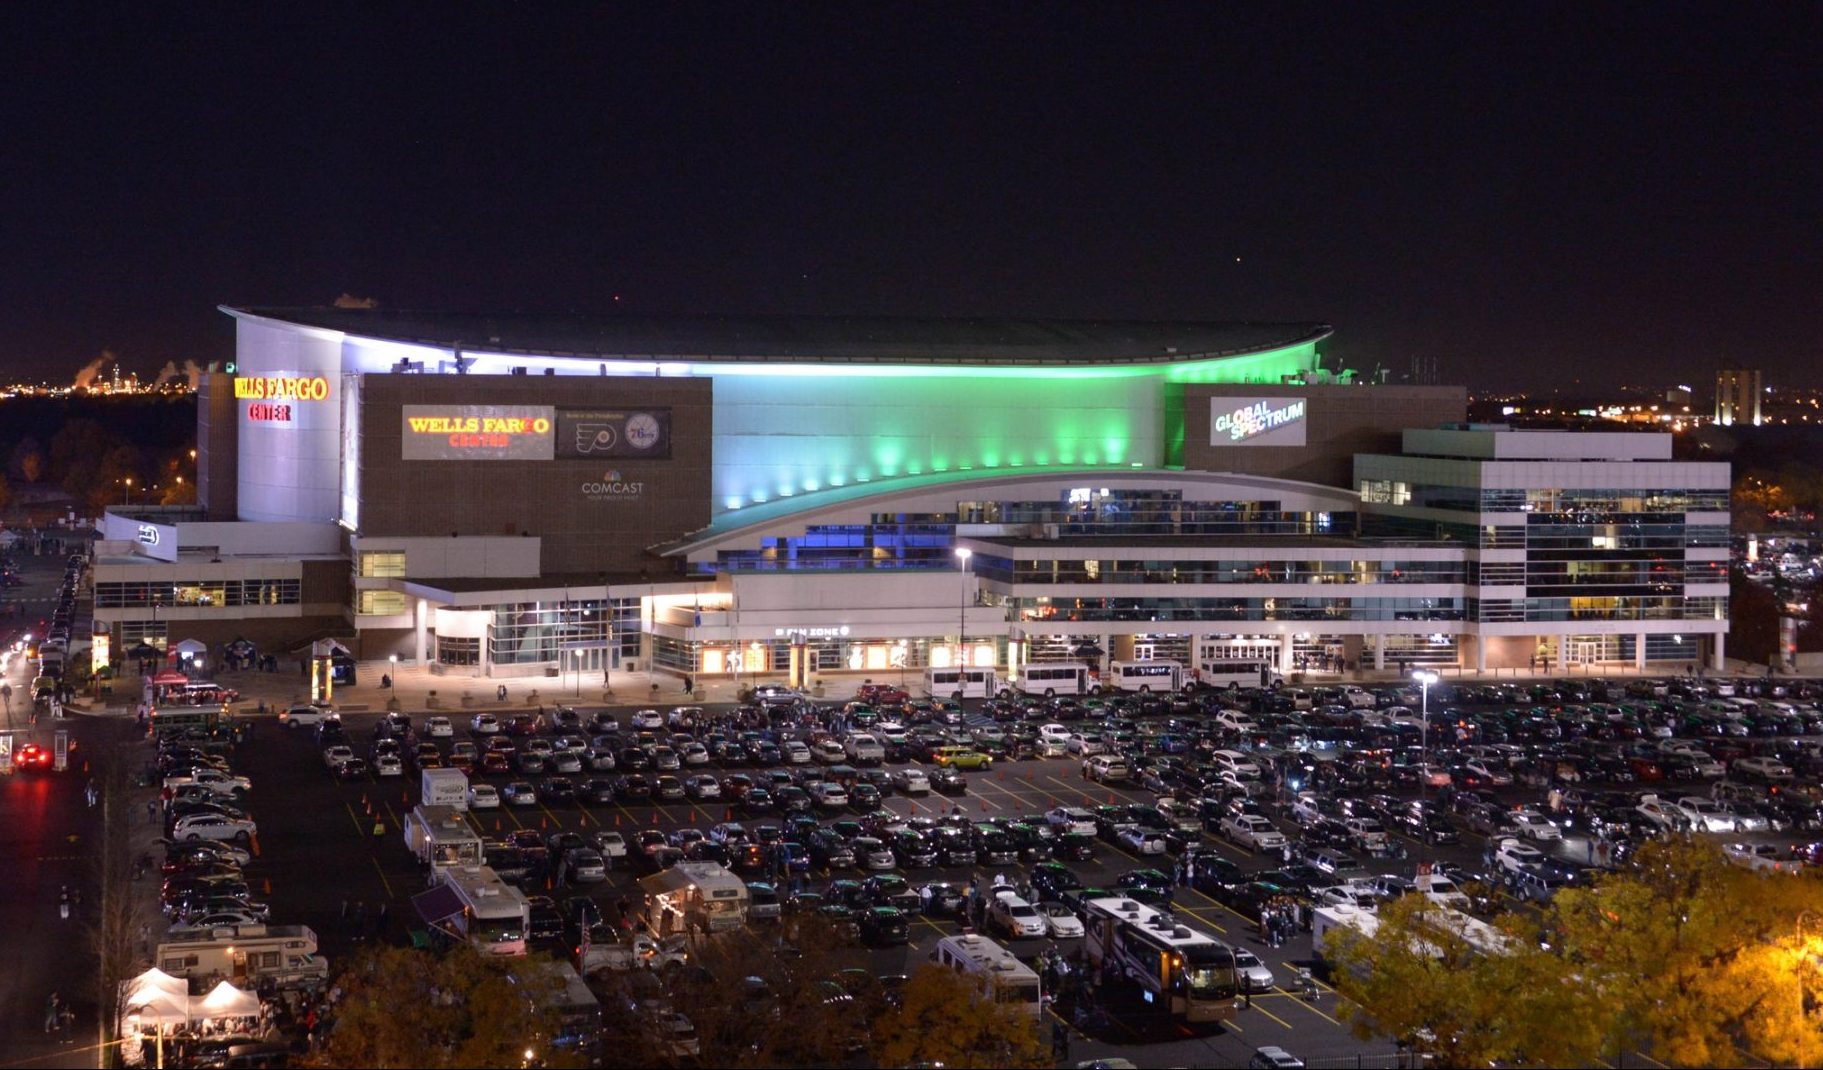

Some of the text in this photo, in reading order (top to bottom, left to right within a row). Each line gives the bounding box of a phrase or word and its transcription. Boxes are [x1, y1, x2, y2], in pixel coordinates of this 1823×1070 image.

[266, 377, 327, 400] FARGO
[248, 404, 291, 421] CENTER
[1215, 401, 1271, 432] GLOBAL
[1230, 401, 1304, 440] SPECTRUM
[408, 417, 479, 433] WELLS
[582, 482, 645, 494] COMCAST
